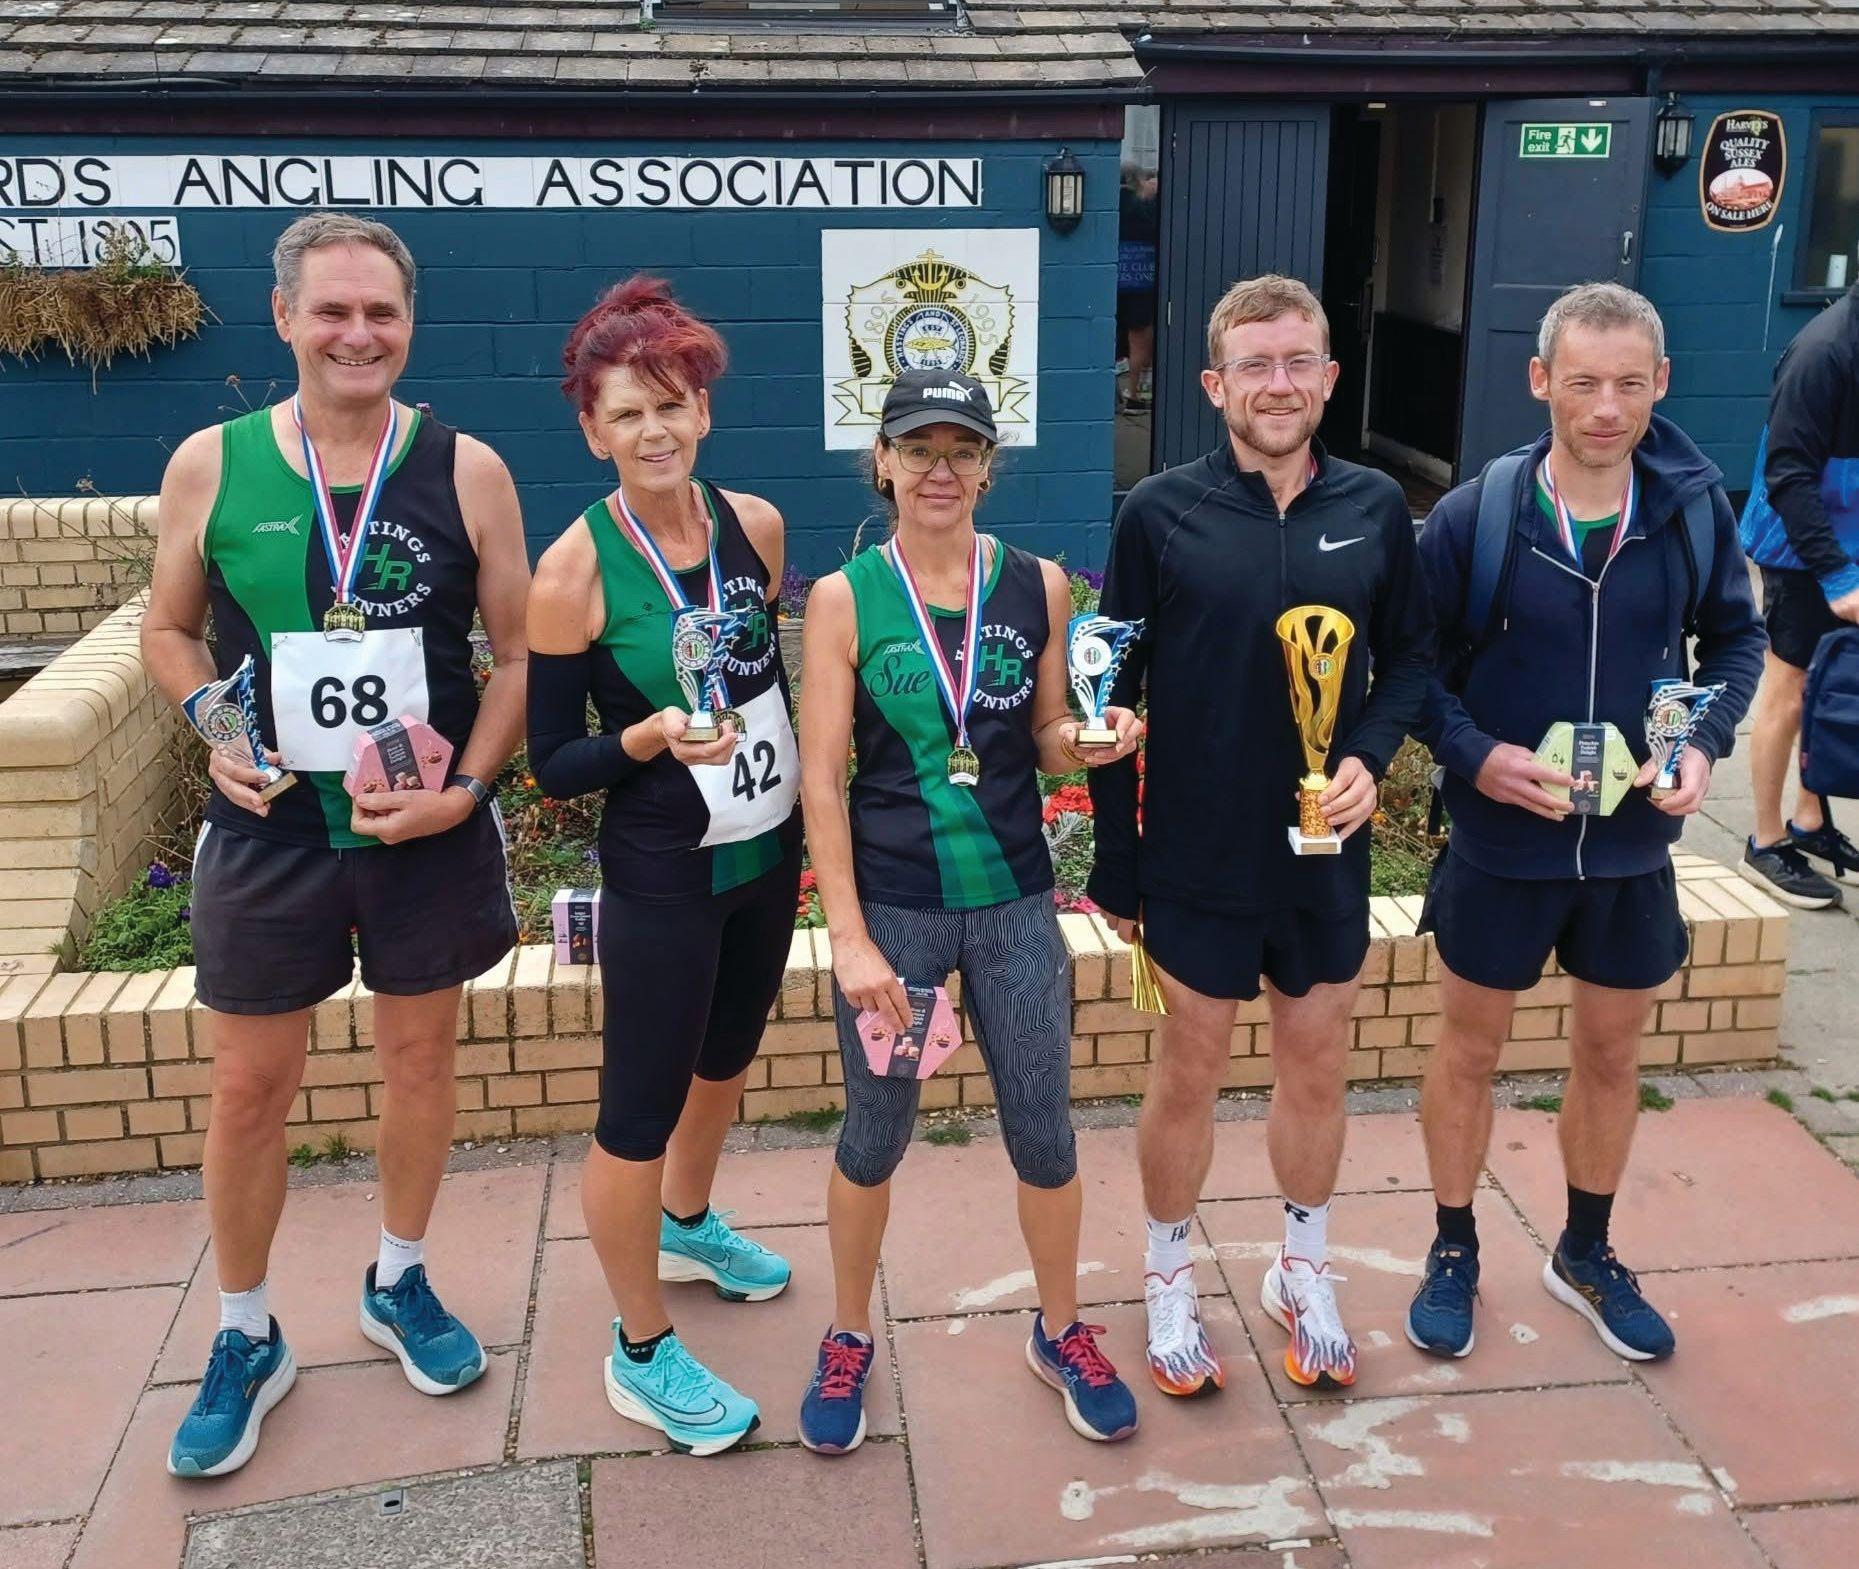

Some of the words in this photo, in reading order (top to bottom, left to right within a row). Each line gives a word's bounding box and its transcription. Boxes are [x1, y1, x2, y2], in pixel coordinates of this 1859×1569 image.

[1528, 129, 1552, 140] Fire
[1527, 141, 1550, 152] exit
[1720, 137, 1770, 150] QUALITY
[1725, 148, 1762, 160] SUSSEX
[1730, 158, 1756, 168] ALES
[173, 158, 484, 206] ANGLING
[536, 158, 981, 206] ASSOCIATION
[1705, 202, 1721, 217] ON
[1721, 209, 1746, 221] SALE
[924, 310, 941, 318] AND
[922, 387, 966, 402] PUMA
[979, 643, 1022, 686] HR
[870, 655, 930, 698] Sue
[310, 675, 388, 729] 68
[732, 740, 782, 802] 42
